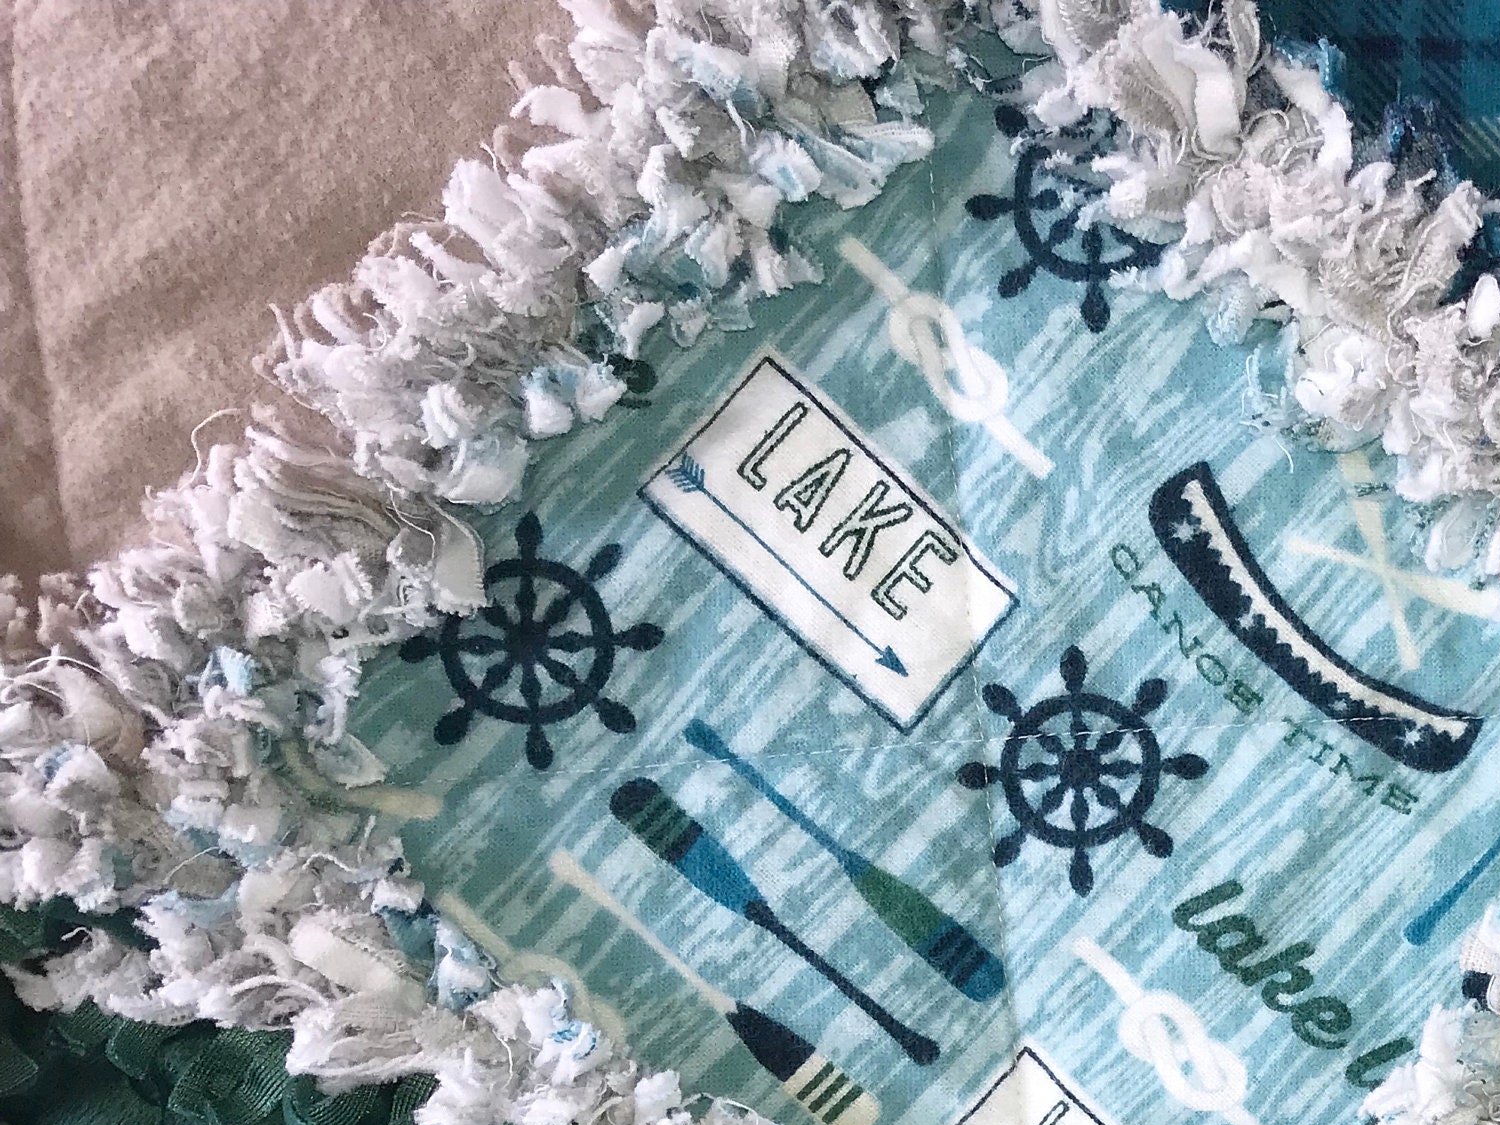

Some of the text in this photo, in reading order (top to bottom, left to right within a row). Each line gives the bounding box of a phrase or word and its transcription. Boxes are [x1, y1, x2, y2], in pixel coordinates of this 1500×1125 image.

[736, 401, 959, 621] LAKE
[1108, 542, 1420, 816] CANOE TIME
[1172, 879, 1352, 1050] lake
